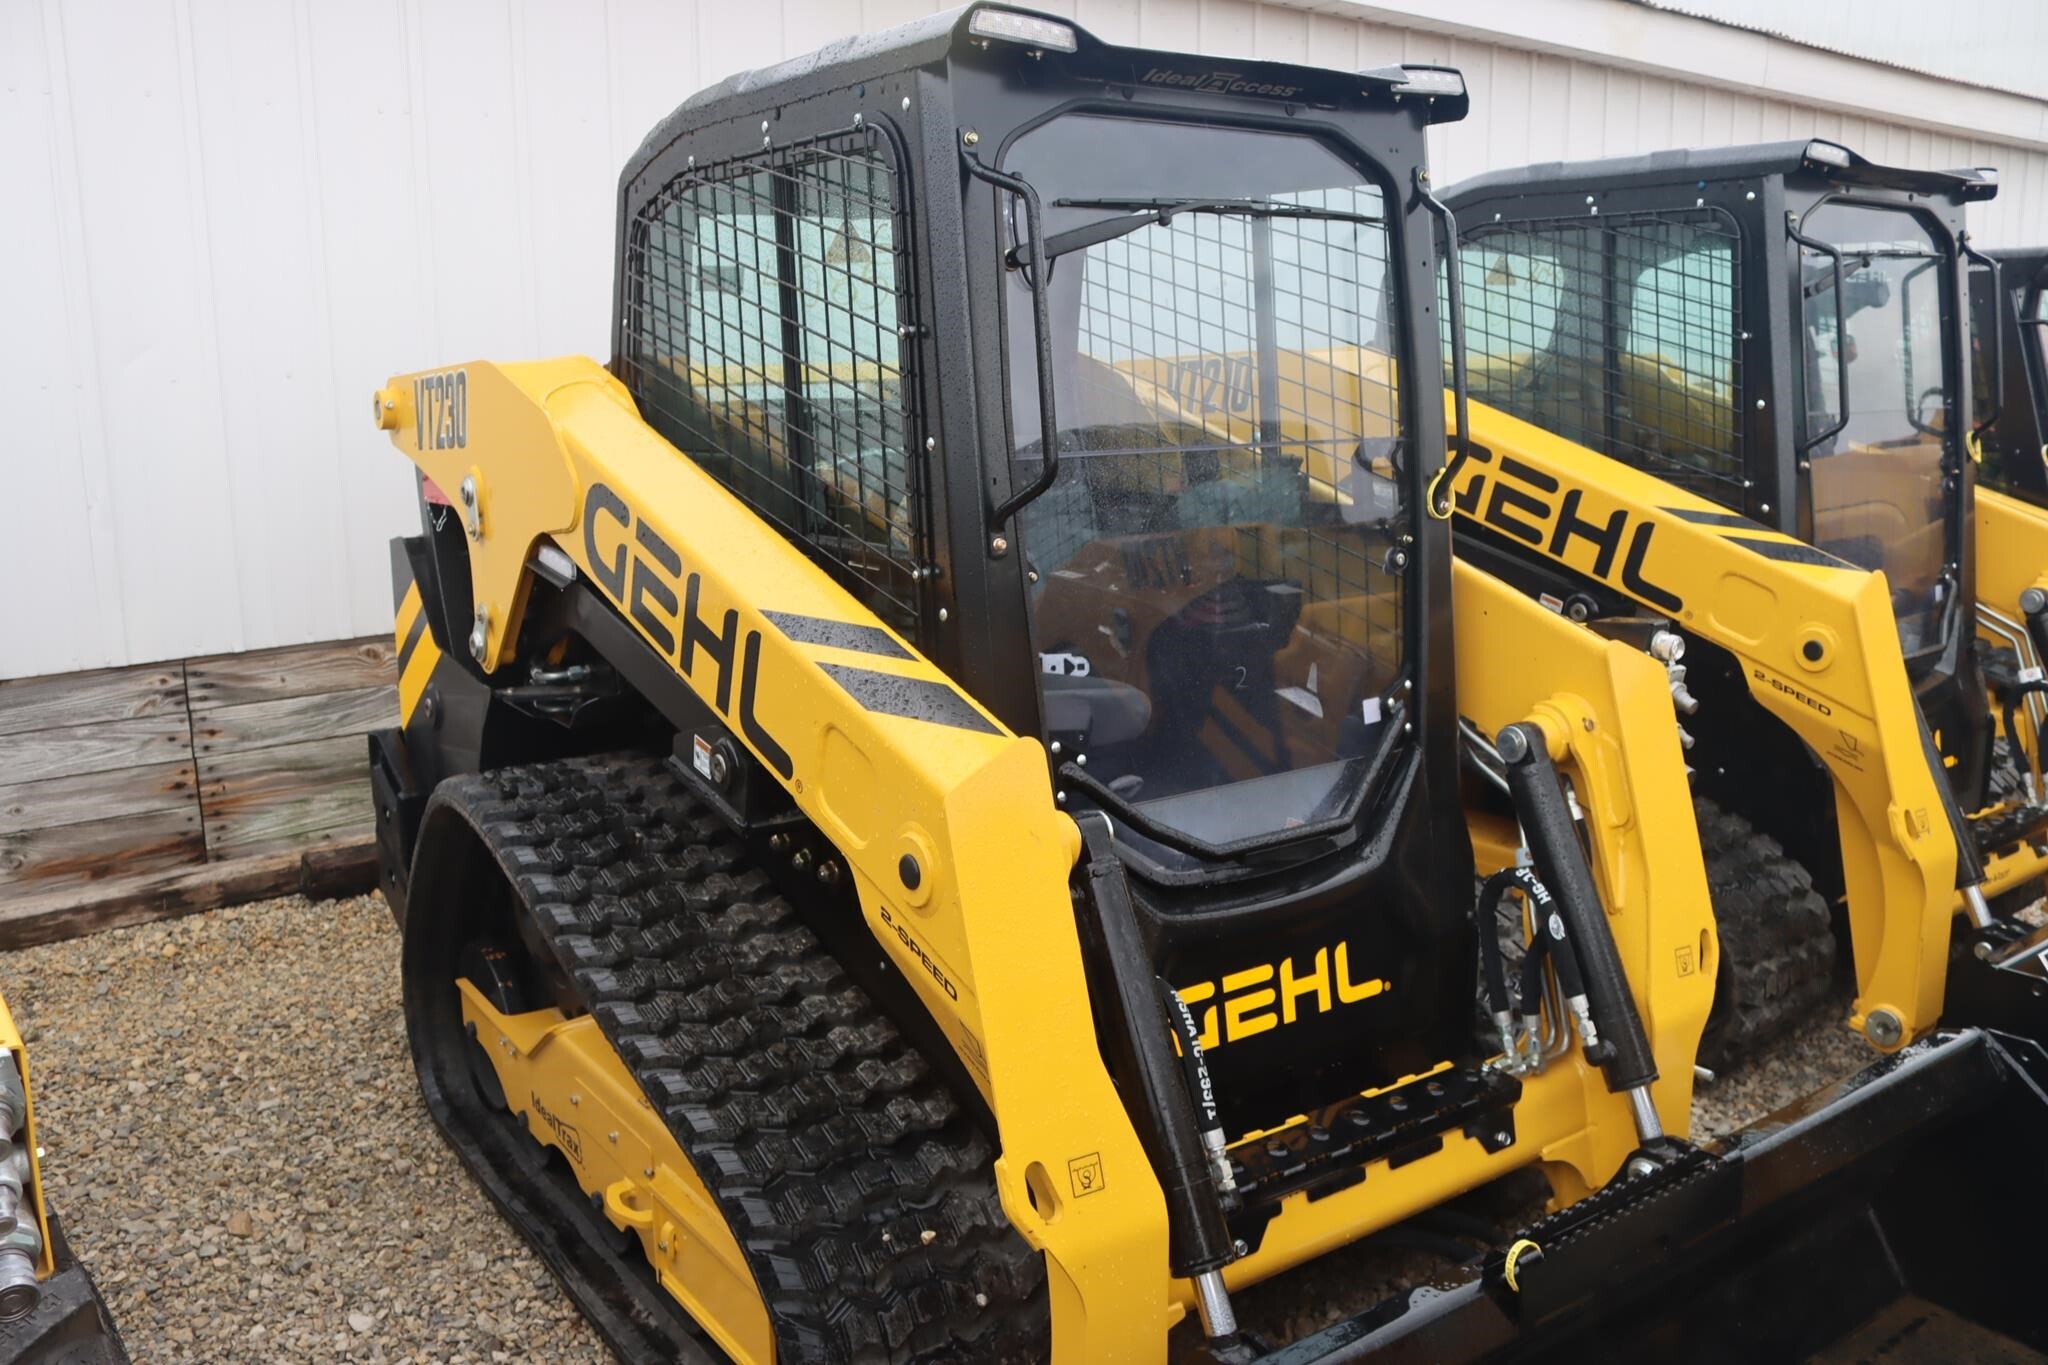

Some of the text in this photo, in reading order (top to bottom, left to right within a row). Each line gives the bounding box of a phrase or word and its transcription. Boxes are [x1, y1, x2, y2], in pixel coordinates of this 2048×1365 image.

[414, 371, 466, 451] VT230
[583, 483, 793, 781] GEHL
[1753, 669, 1831, 716] 2-SPEED
[880, 906, 958, 1001] 2-SPEED
